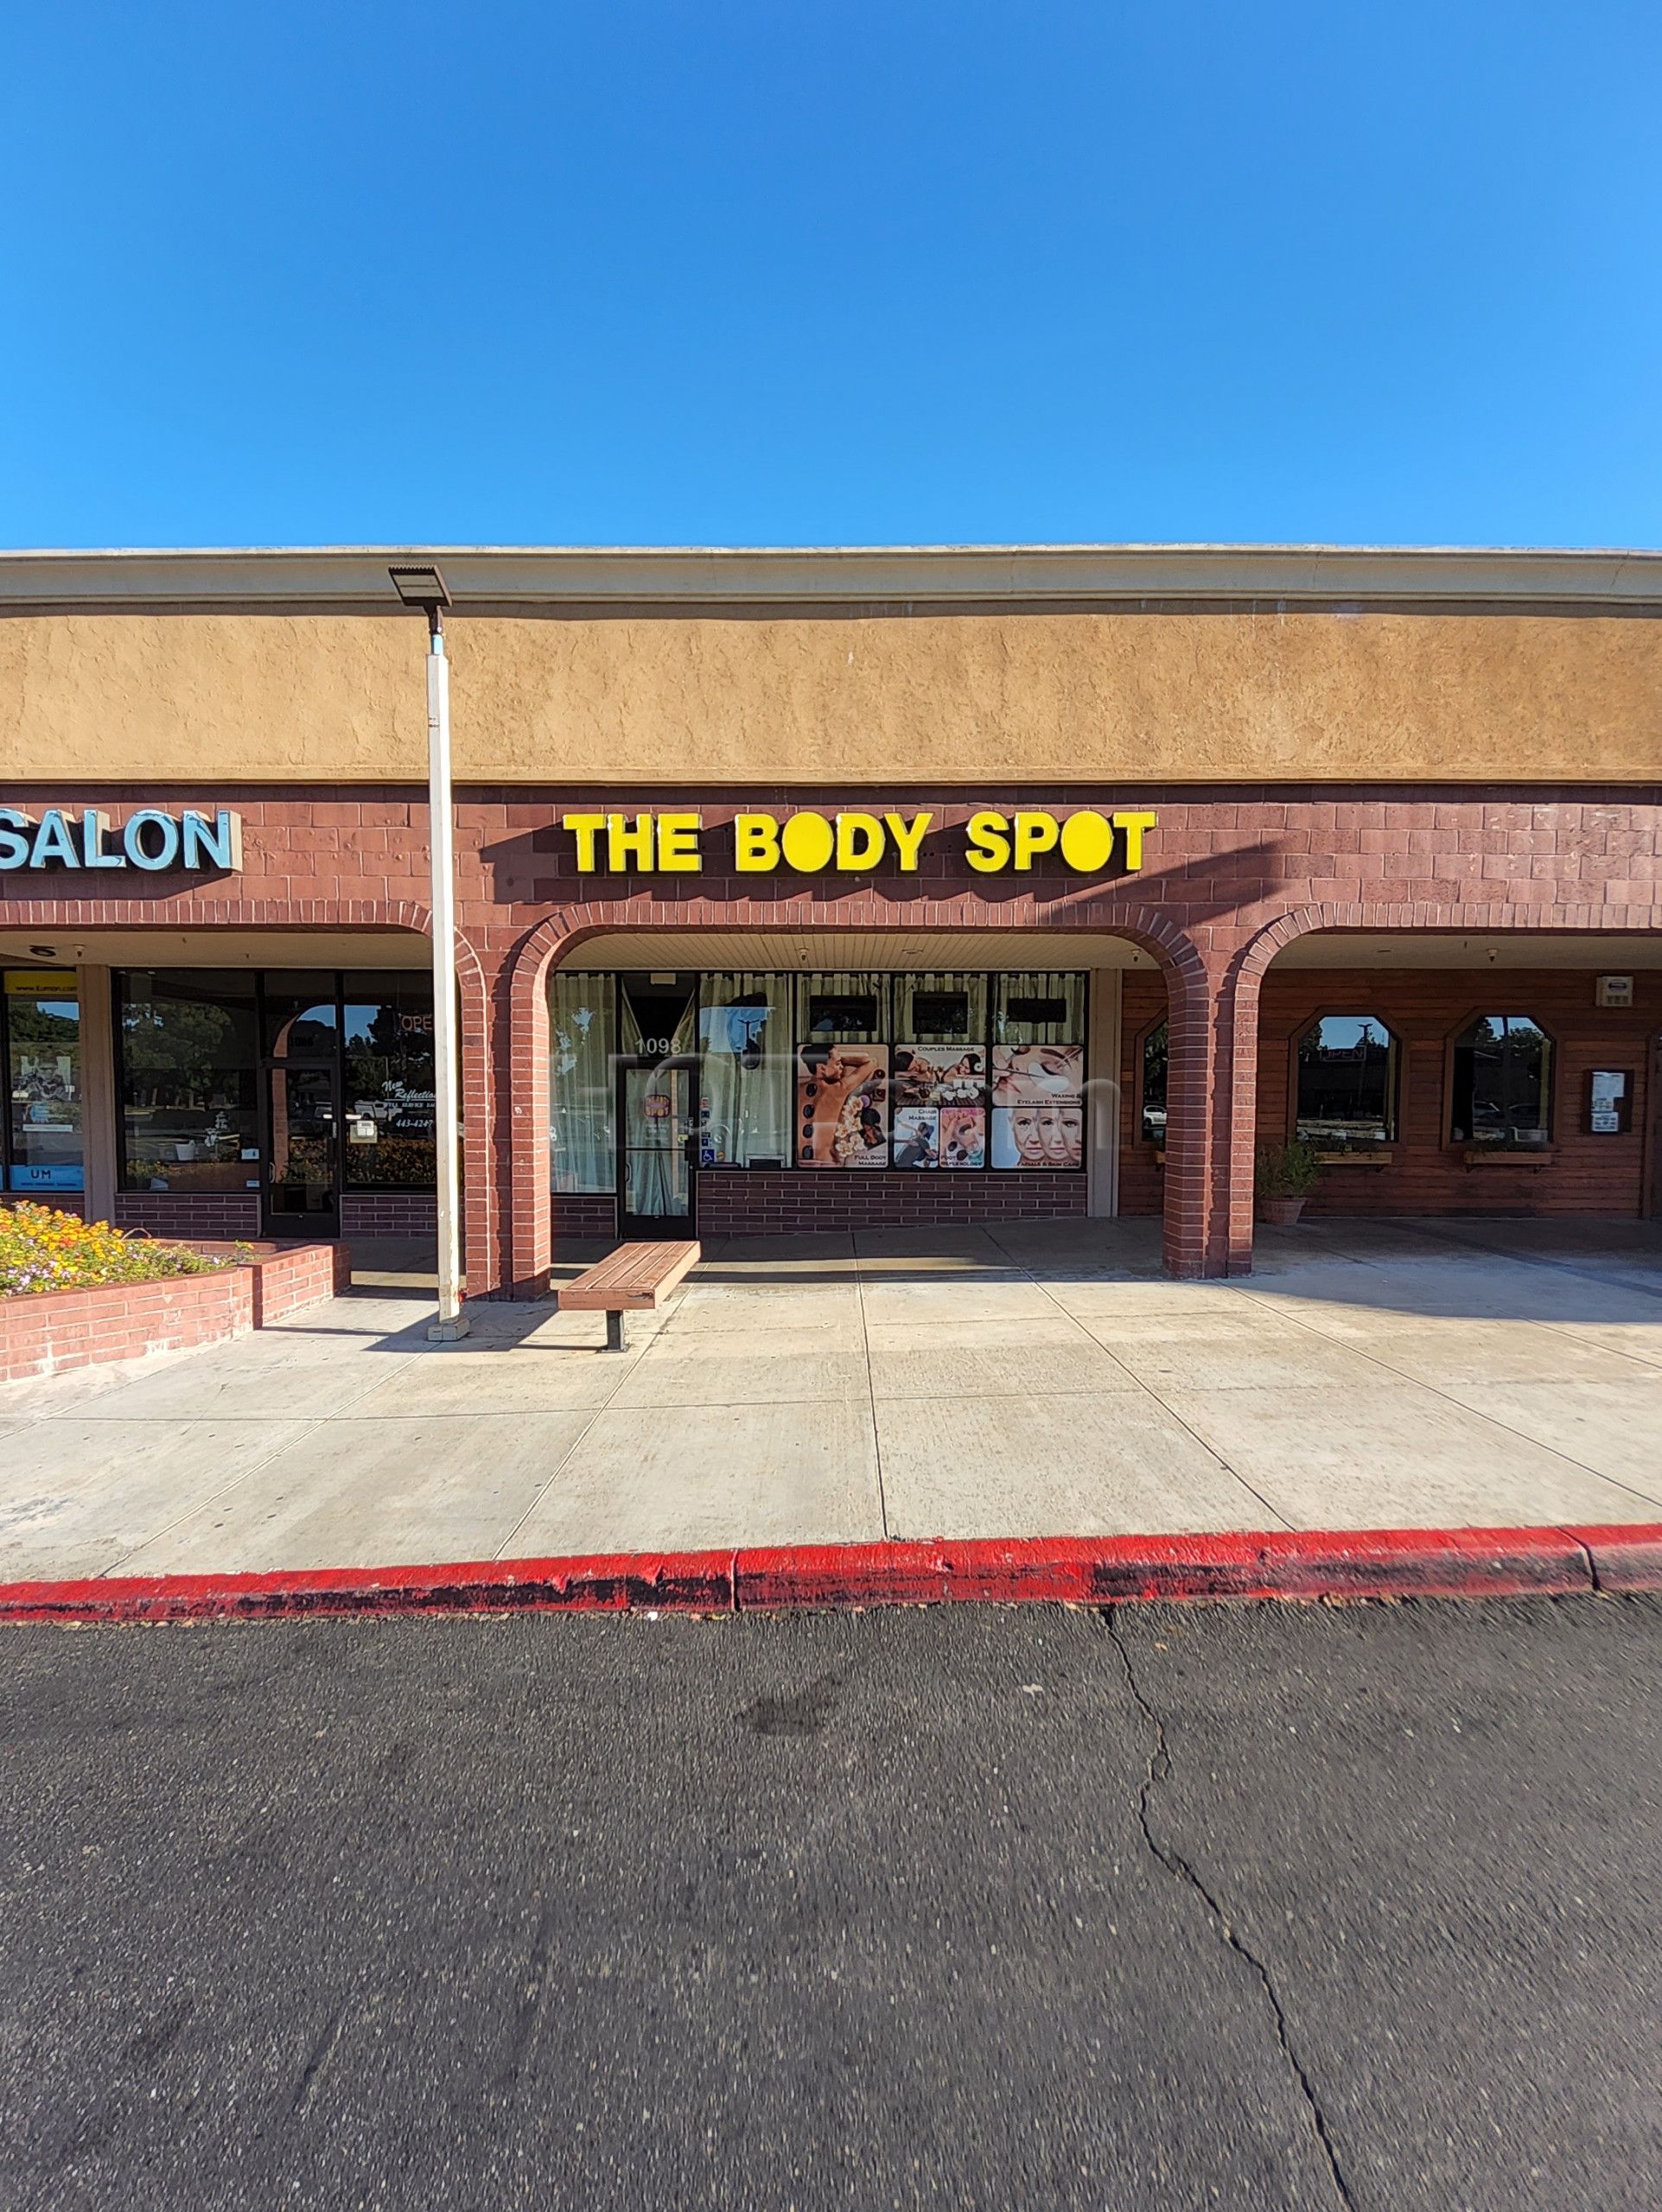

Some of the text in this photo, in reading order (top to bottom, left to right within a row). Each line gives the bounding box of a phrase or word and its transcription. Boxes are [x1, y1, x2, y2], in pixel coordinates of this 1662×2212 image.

[0, 808, 236, 871] SALON
[564, 810, 1157, 873] THE BODY SPOT
[401, 1015, 434, 1032] OPE
[635, 1038, 681, 1053] 1098
[395, 1088, 436, 1103] Reflectio
